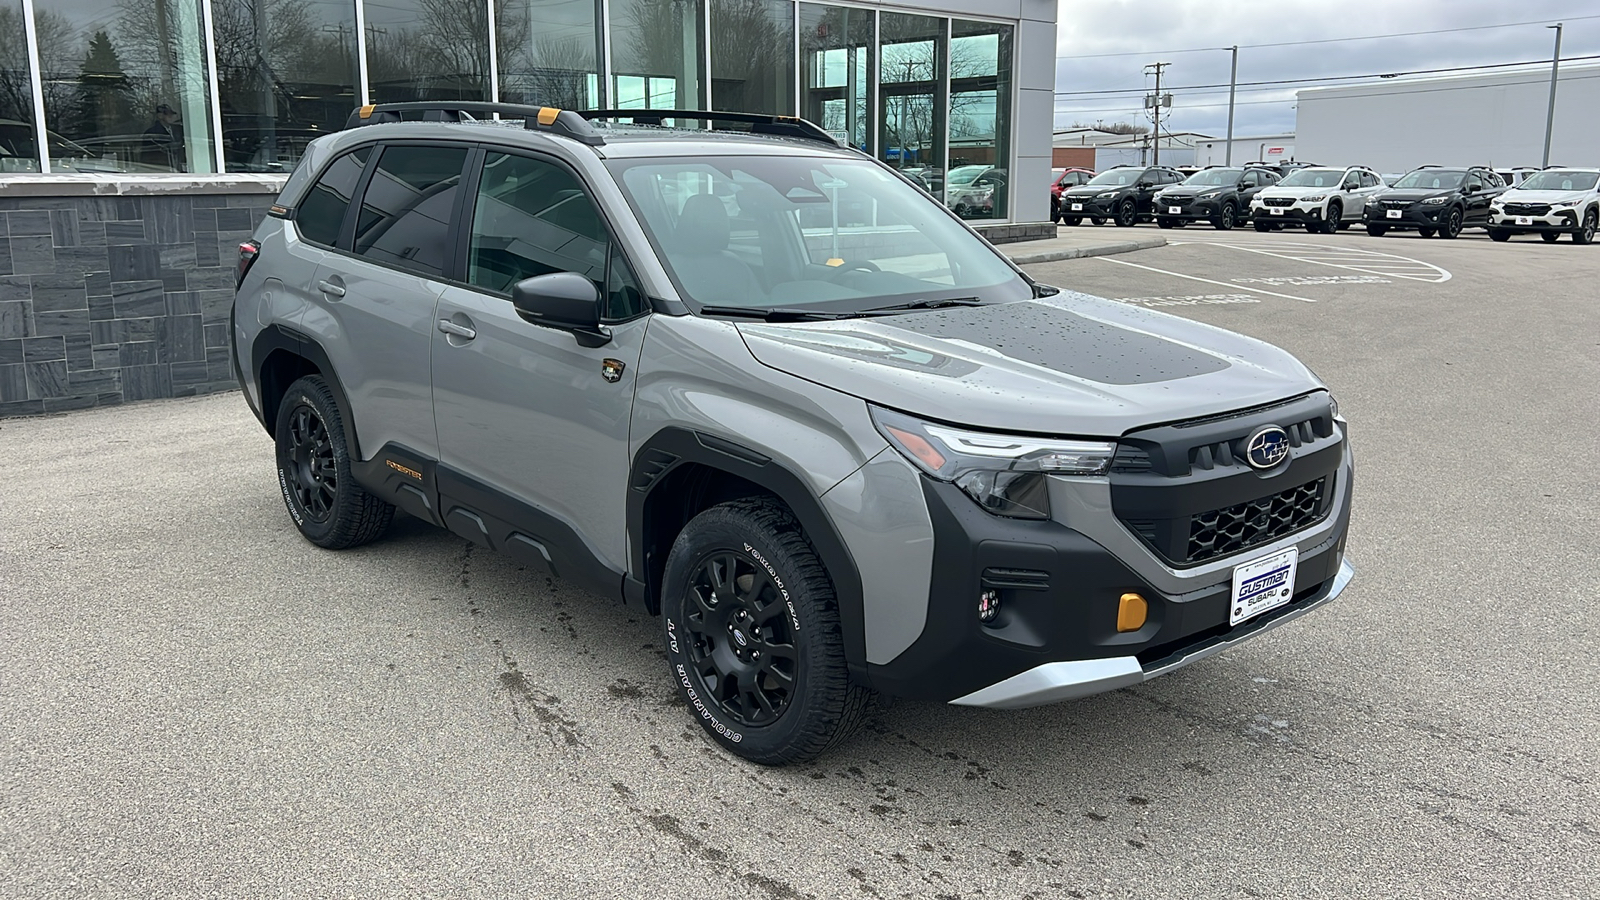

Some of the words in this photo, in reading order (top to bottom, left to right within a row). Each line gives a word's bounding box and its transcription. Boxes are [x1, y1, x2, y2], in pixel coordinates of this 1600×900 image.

[386, 459, 422, 480] FORESTER
[743, 542, 800, 631] YOKOHAMA
[1247, 589, 1277, 606] SUBARU
[667, 618, 679, 653] A/T
[676, 663, 743, 743] GEOLANDAR
